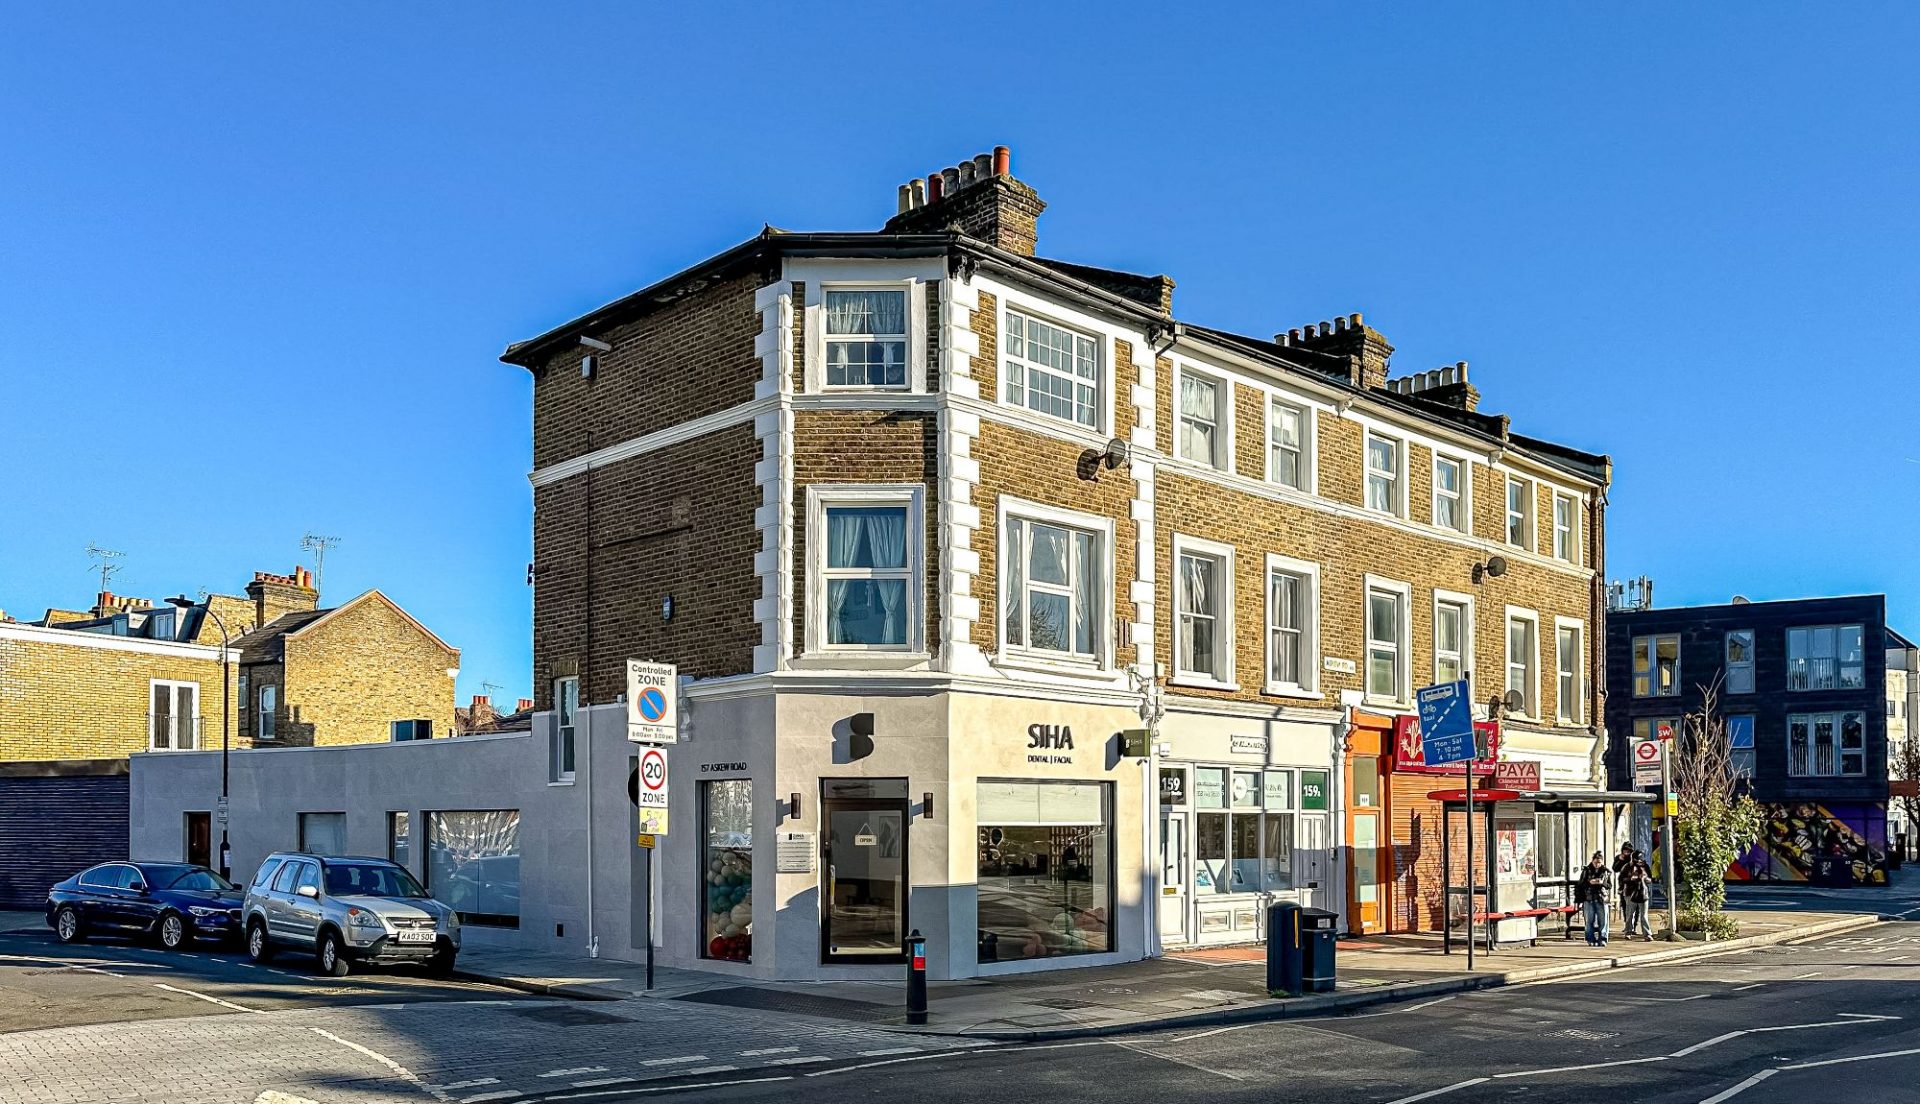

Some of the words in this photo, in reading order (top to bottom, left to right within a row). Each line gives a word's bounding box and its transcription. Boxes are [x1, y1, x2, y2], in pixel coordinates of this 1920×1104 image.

[631, 664, 672, 676] Controlled
[638, 675, 666, 686] ZONE
[1028, 723, 1074, 750] SIHA
[1451, 737, 1463, 746] Sat
[645, 762, 662, 780] 20
[1498, 763, 1537, 777] PAYA
[1161, 777, 1181, 791] 159
[642, 792, 666, 803] ZONE
